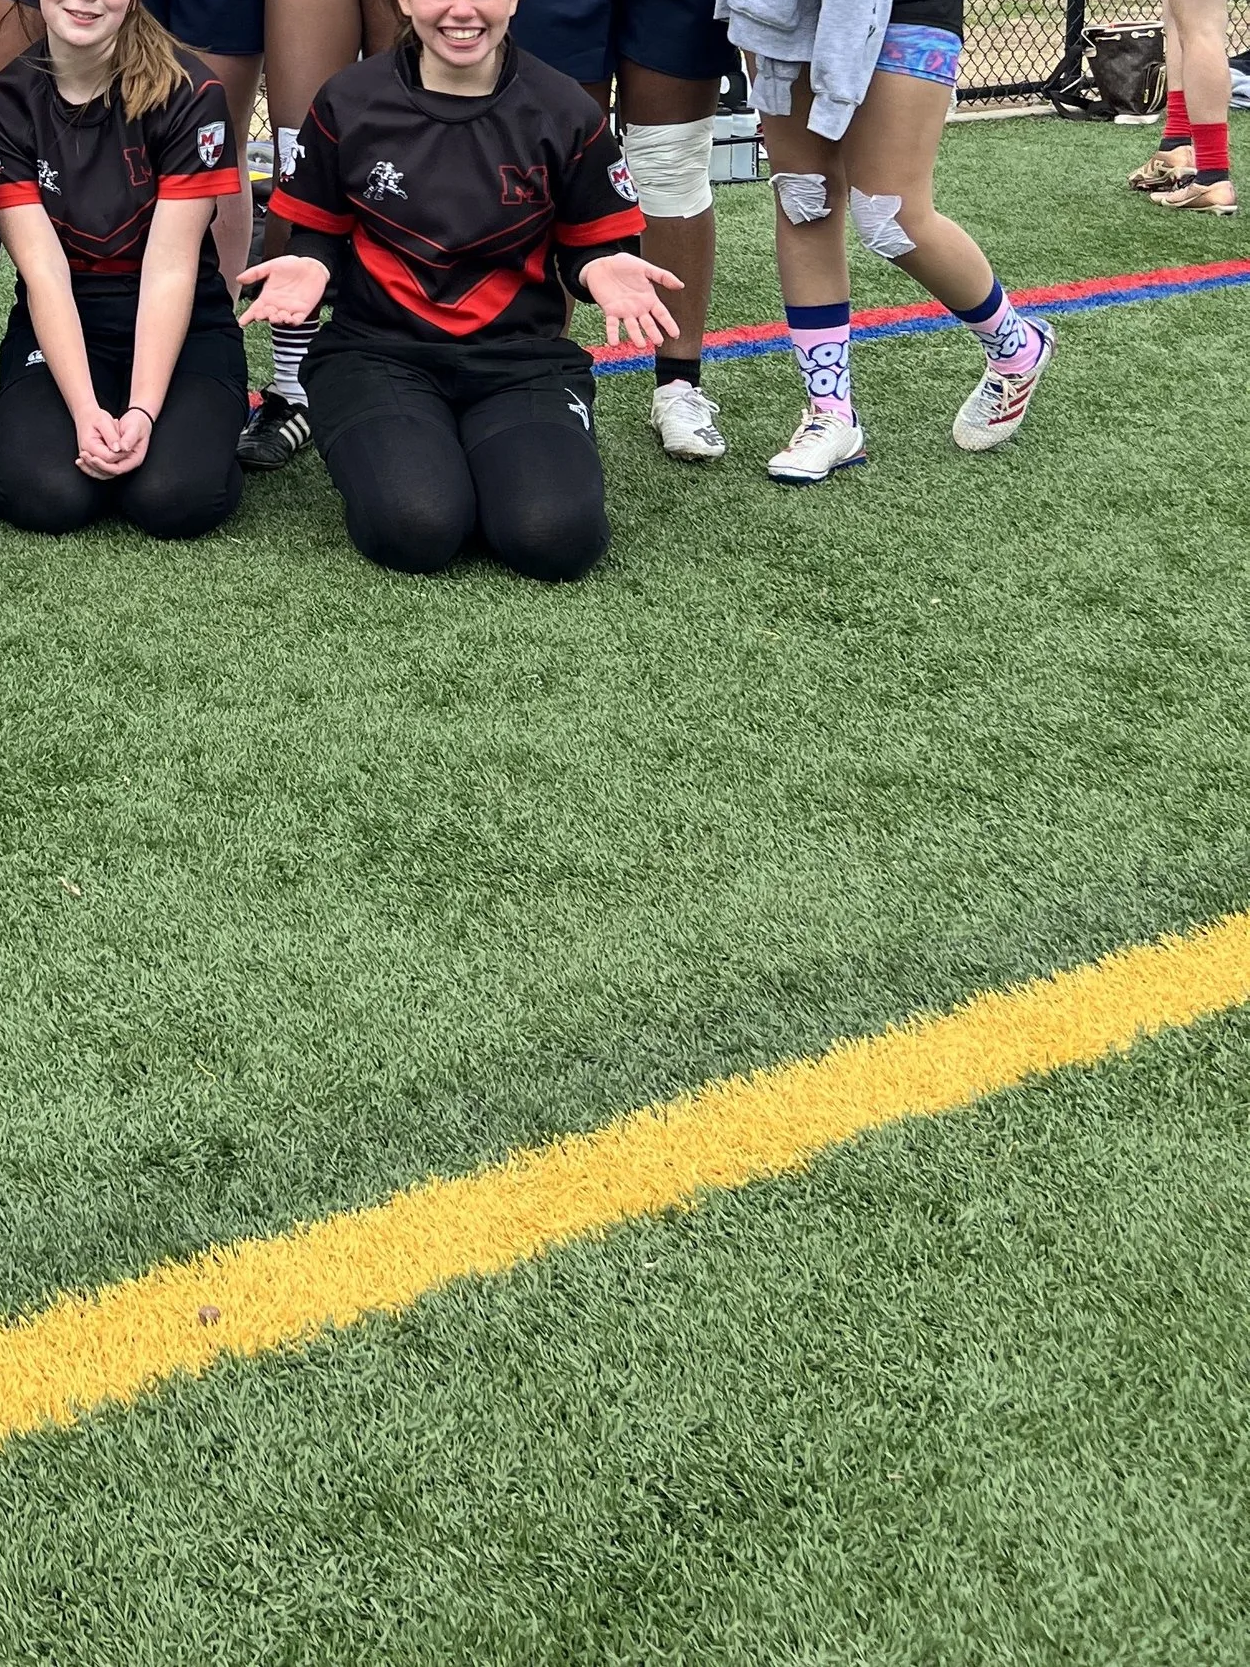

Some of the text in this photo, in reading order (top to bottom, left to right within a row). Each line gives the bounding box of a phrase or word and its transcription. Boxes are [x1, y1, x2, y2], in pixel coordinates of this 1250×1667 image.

[201, 132, 215, 146] M
[611, 167, 629, 184] M
[499, 165, 550, 205] M
